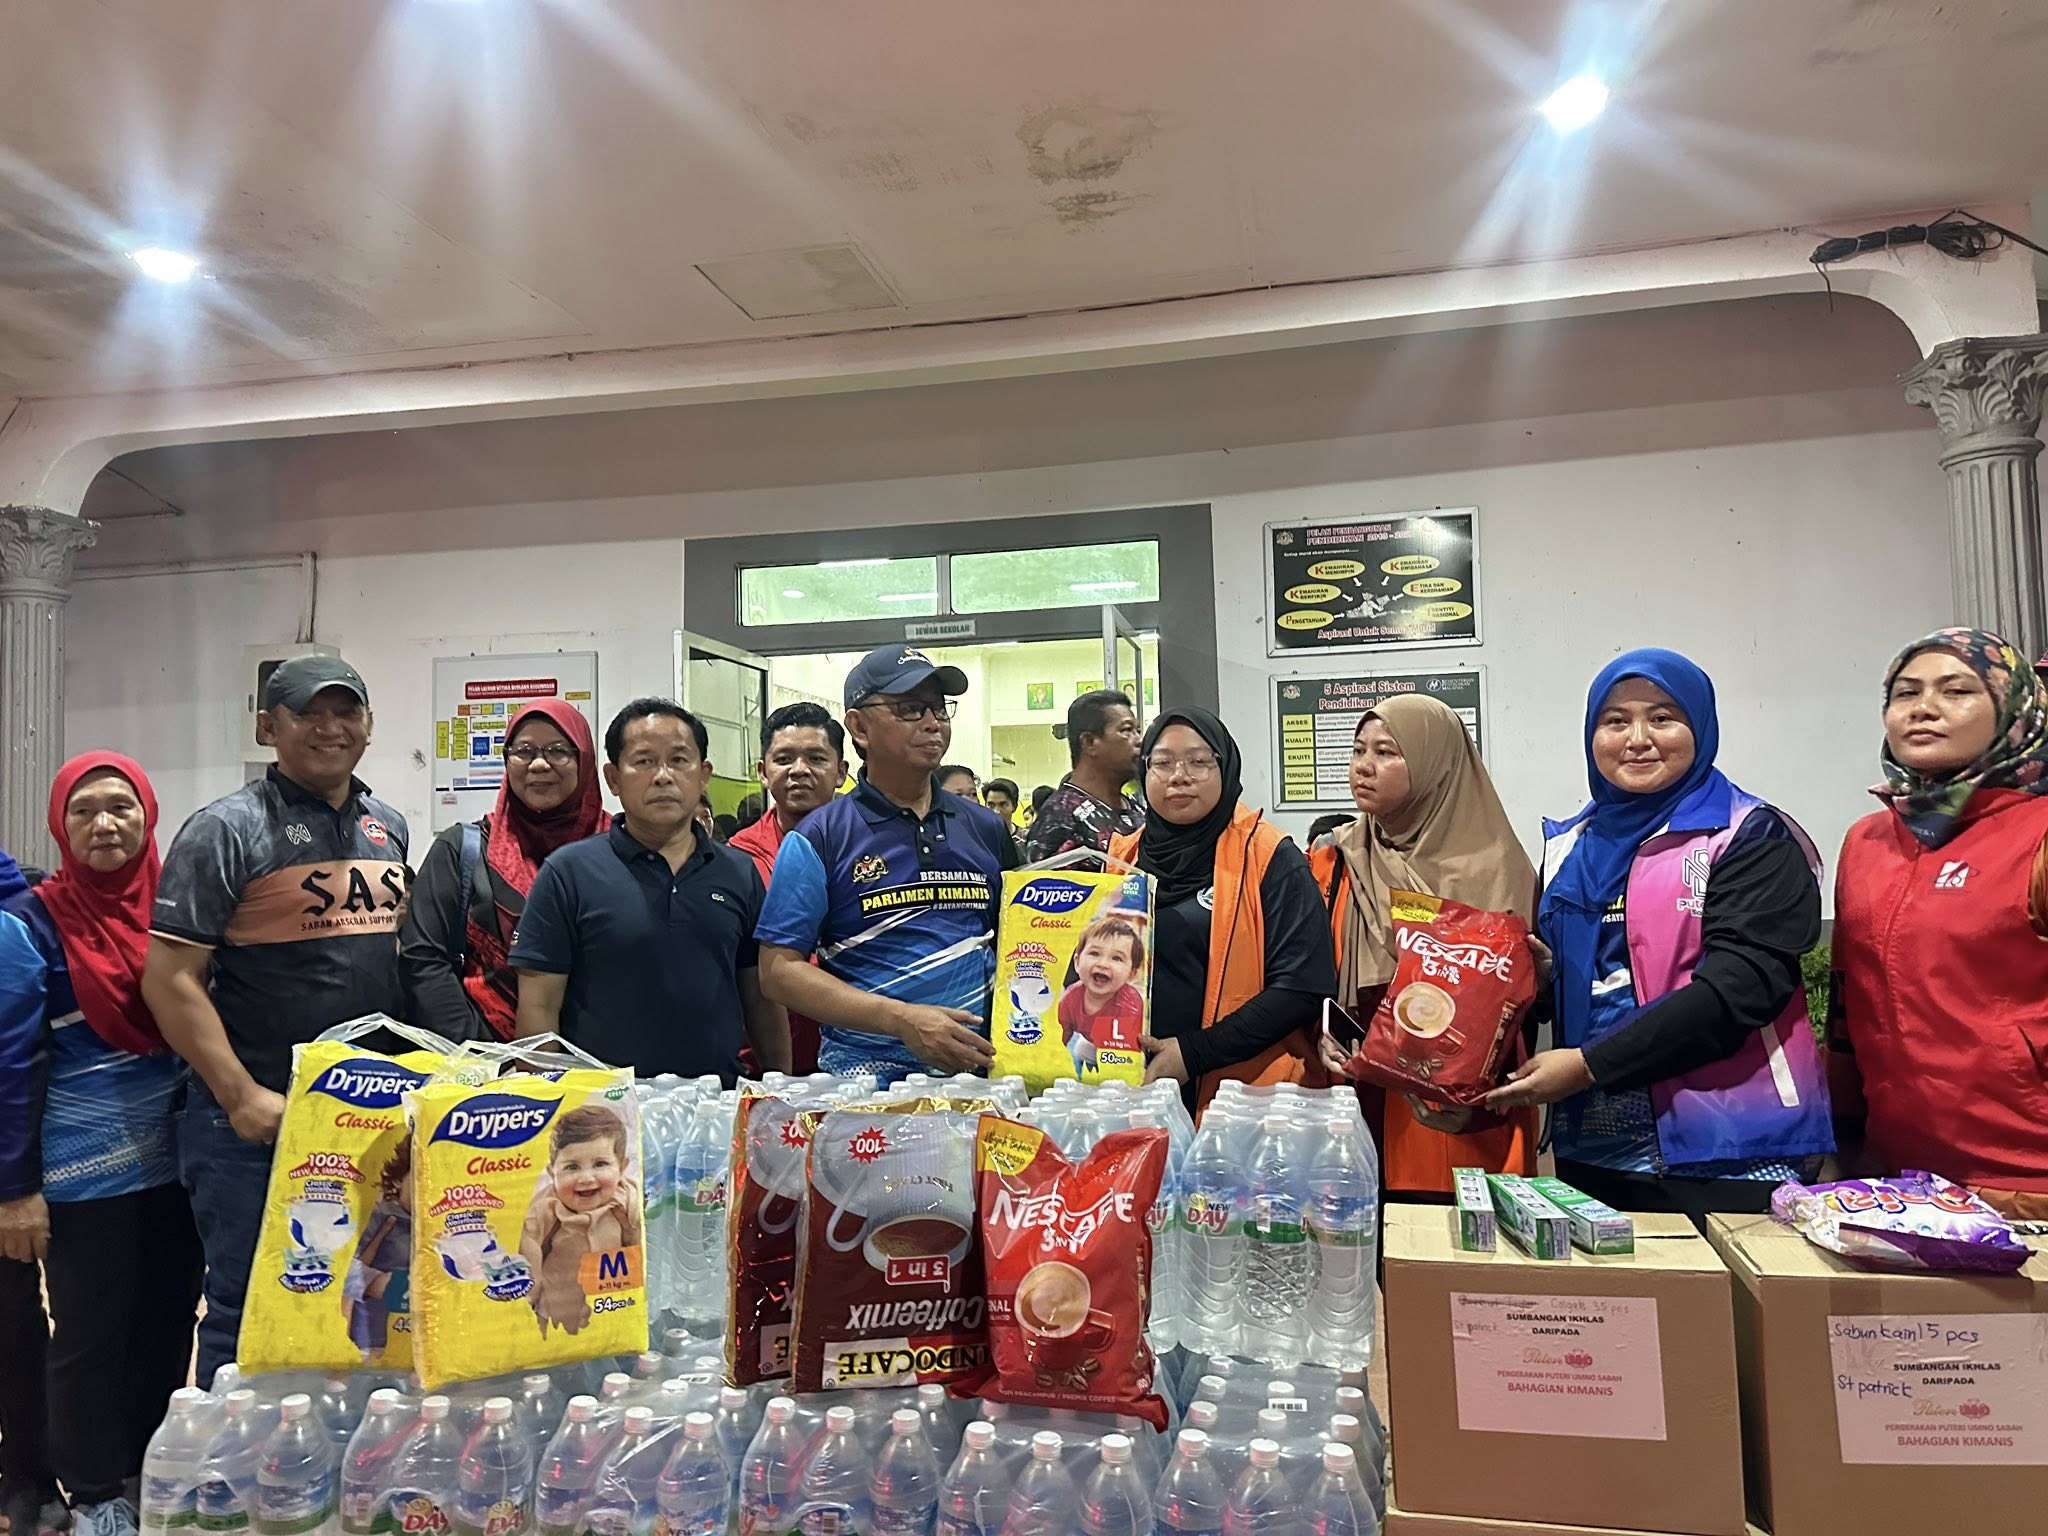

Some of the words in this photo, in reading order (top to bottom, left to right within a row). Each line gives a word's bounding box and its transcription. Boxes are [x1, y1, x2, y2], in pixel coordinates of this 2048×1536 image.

[1307, 534, 1365, 545] PENDIDIKAN
[940, 624, 970, 634] SEKOLAH
[1354, 627, 1380, 636] Untuk
[1324, 684, 1332, 695] 5
[1333, 681, 1376, 696] Aspirasi
[1377, 680, 1416, 693] Sistem
[1319, 698, 1375, 710] Pendidikan
[920, 870, 969, 881] BERSAMA
[301, 866, 403, 917] SAS
[862, 887, 934, 912] PARLIMEN
[938, 887, 990, 901] KIMANIS
[1022, 886, 1084, 906] Drypers
[301, 919, 332, 931] SABAH
[1030, 916, 1072, 929] Classic
[1017, 942, 1046, 953] 100%
[1006, 953, 1020, 962] NEW
[1026, 952, 1057, 964] IMPROVED
[1112, 1018, 1125, 1040] L
[325, 1067, 417, 1098] Drypers
[335, 1111, 394, 1131] Classic
[448, 1108, 545, 1140] Drypers
[856, 1138, 882, 1154] 100
[309, 1152, 351, 1169] 100%
[467, 1153, 532, 1176] Classic
[289, 1167, 310, 1179] NEW
[312, 1167, 321, 1175] &
[321, 1166, 364, 1183] IMPROVED
[444, 1183, 487, 1202] 100%
[695, 1188, 726, 1206] DA
[430, 1202, 450, 1217] NEW
[451, 1201, 459, 1209] &
[460, 1198, 504, 1209] IMPROVED
[1208, 1202, 1232, 1211] NEW
[1145, 1208, 1169, 1231] AY
[1187, 1207, 1230, 1234] DAY
[599, 1251, 629, 1281] M
[891, 1263, 901, 1279] 1
[908, 1262, 927, 1278] in
[932, 1260, 944, 1277] 3
[1550, 1297, 1587, 1313] Colgate
[1593, 1299, 1608, 1311] 35
[845, 1295, 985, 1336] Coffeemix
[1506, 1313, 1567, 1322] SUMBANGAN
[1568, 1314, 1605, 1323] IKHLAS
[1531, 1327, 1581, 1336] DARIPADA
[1834, 1323, 1877, 1340] Sabun
[1880, 1323, 1916, 1342] kain
[1946, 1330, 1979, 1347] pcs
[1893, 1363, 1960, 1371] SUMBANGAN
[1962, 1363, 2001, 1371] IKHLAS
[1497, 1370, 1544, 1379] PERGERAKAN
[1545, 1372, 1571, 1380] PUTERI
[1571, 1373, 1596, 1381] UMNO
[1597, 1374, 1622, 1382] SABAH
[1922, 1377, 1975, 1385] DARIPADA
[1507, 1382, 1564, 1394] BAHAGIAN
[1567, 1384, 1614, 1396] KIMANIS
[1838, 1374, 1855, 1390] St
[1858, 1379, 1913, 1399] patrick
[1014, 1390, 1056, 1400] PRACAMPUR
[1062, 1393, 1089, 1402] PREMIX
[1089, 1394, 1116, 1403] COFFEE
[1995, 1424, 2023, 1432] SABAH
[1897, 1436, 1959, 1447] BAHAGIAN
[1962, 1436, 2014, 1447] KIMANIS
